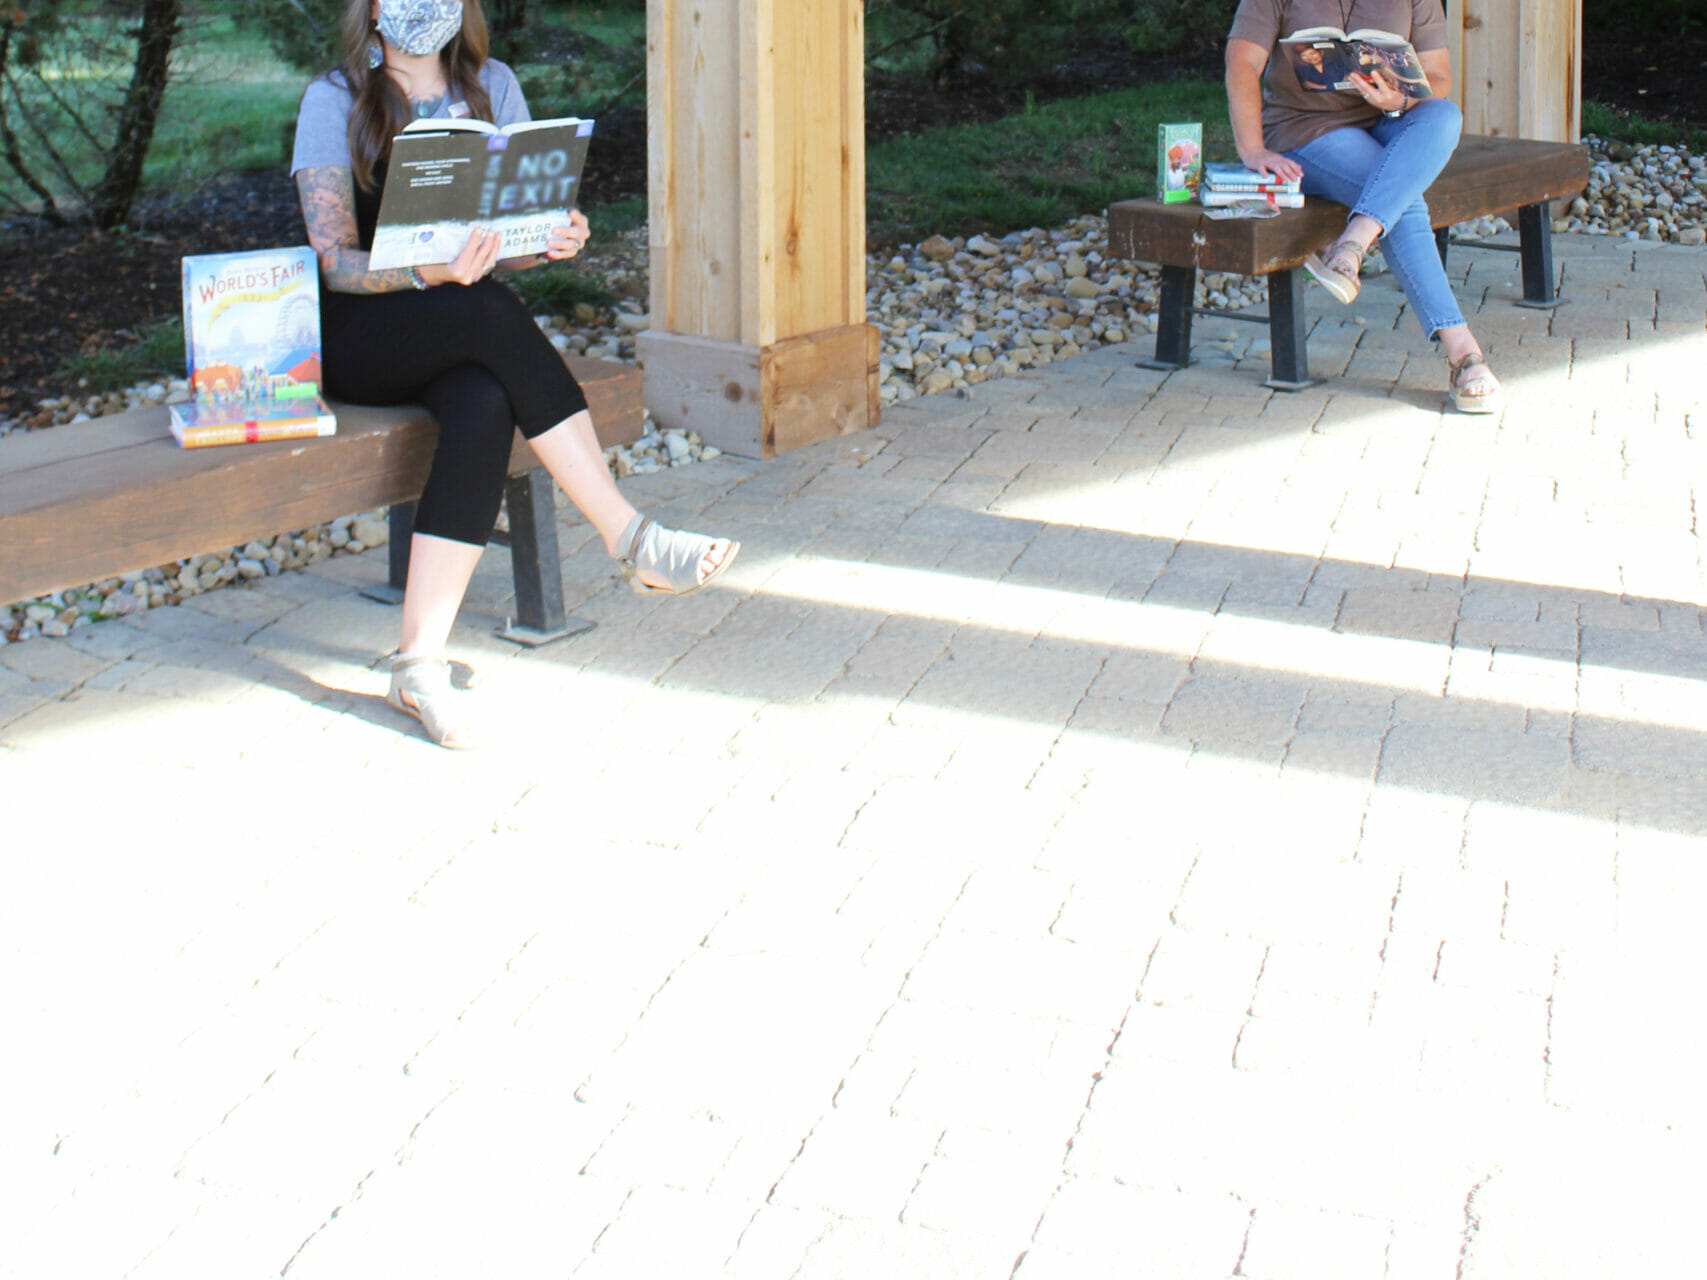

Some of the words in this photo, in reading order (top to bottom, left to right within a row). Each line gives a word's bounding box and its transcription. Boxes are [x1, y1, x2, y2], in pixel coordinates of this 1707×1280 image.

[517, 148, 568, 179] NO
[498, 175, 577, 210] EXIT
[504, 234, 548, 249] ADAMS
[505, 223, 552, 238] TAYLOR
[199, 272, 269, 305] WORLD'S
[271, 260, 305, 288] FAIR
